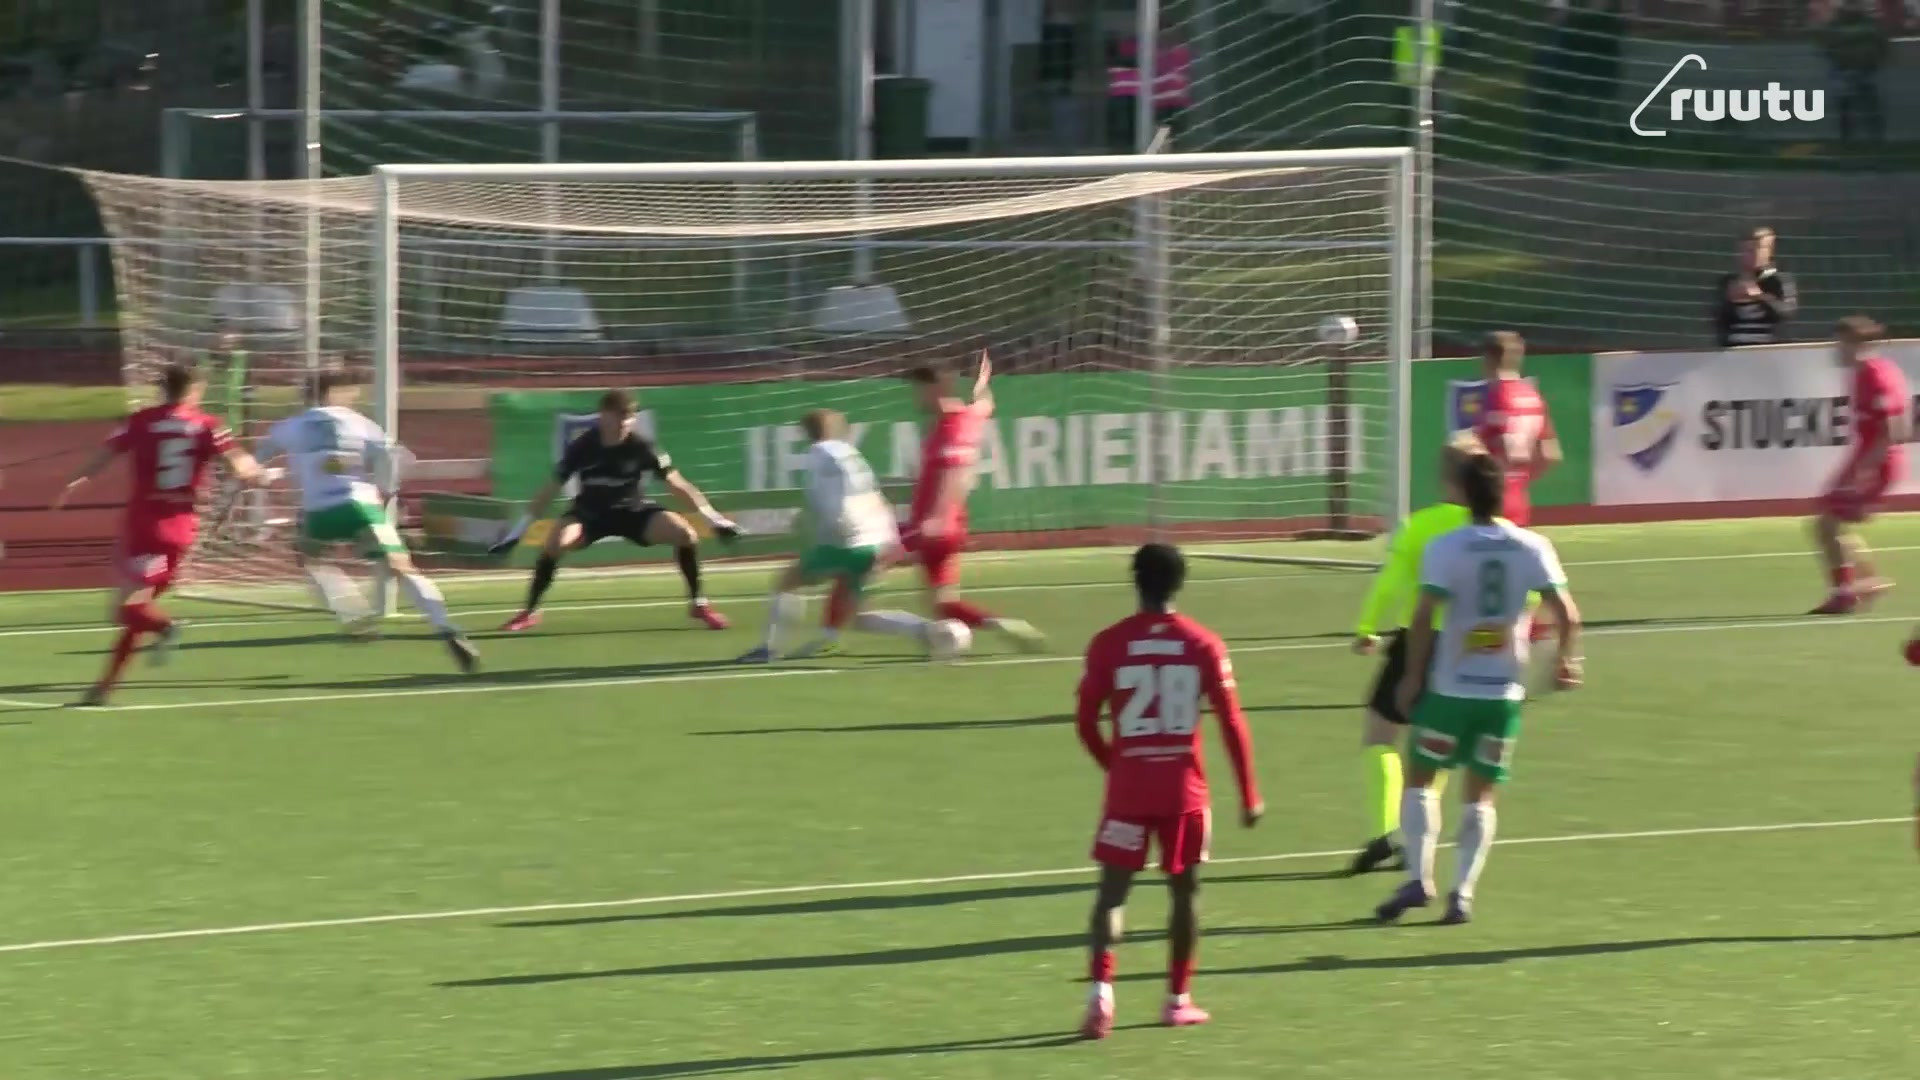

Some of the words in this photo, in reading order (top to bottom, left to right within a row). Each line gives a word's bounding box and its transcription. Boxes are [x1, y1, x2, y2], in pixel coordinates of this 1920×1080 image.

[156, 436, 197, 490] 5
[1477, 557, 1508, 617] 8
[1114, 664, 1201, 738] 28
